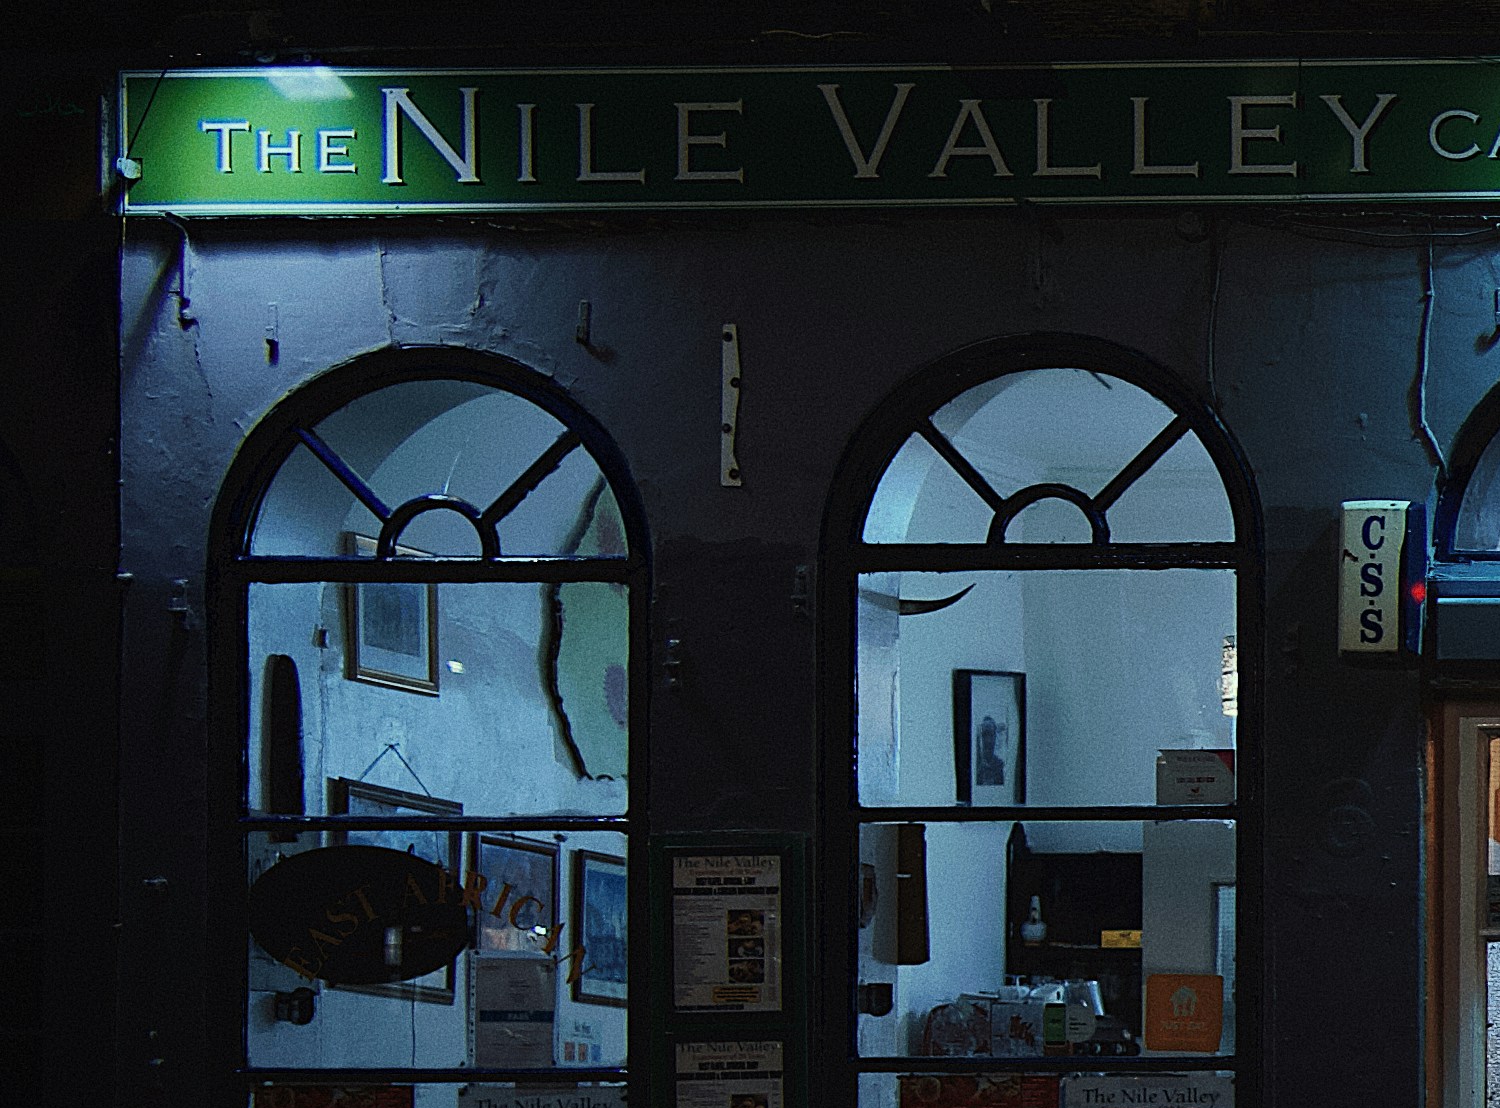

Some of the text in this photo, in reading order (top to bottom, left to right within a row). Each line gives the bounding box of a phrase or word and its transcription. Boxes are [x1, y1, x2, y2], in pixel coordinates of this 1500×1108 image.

[380, 86, 745, 185] NILE
[816, 82, 1400, 183] VALLEY
[283, 883, 381, 981] EAST
[1082, 1087, 1221, 1108] The Nile Valley
